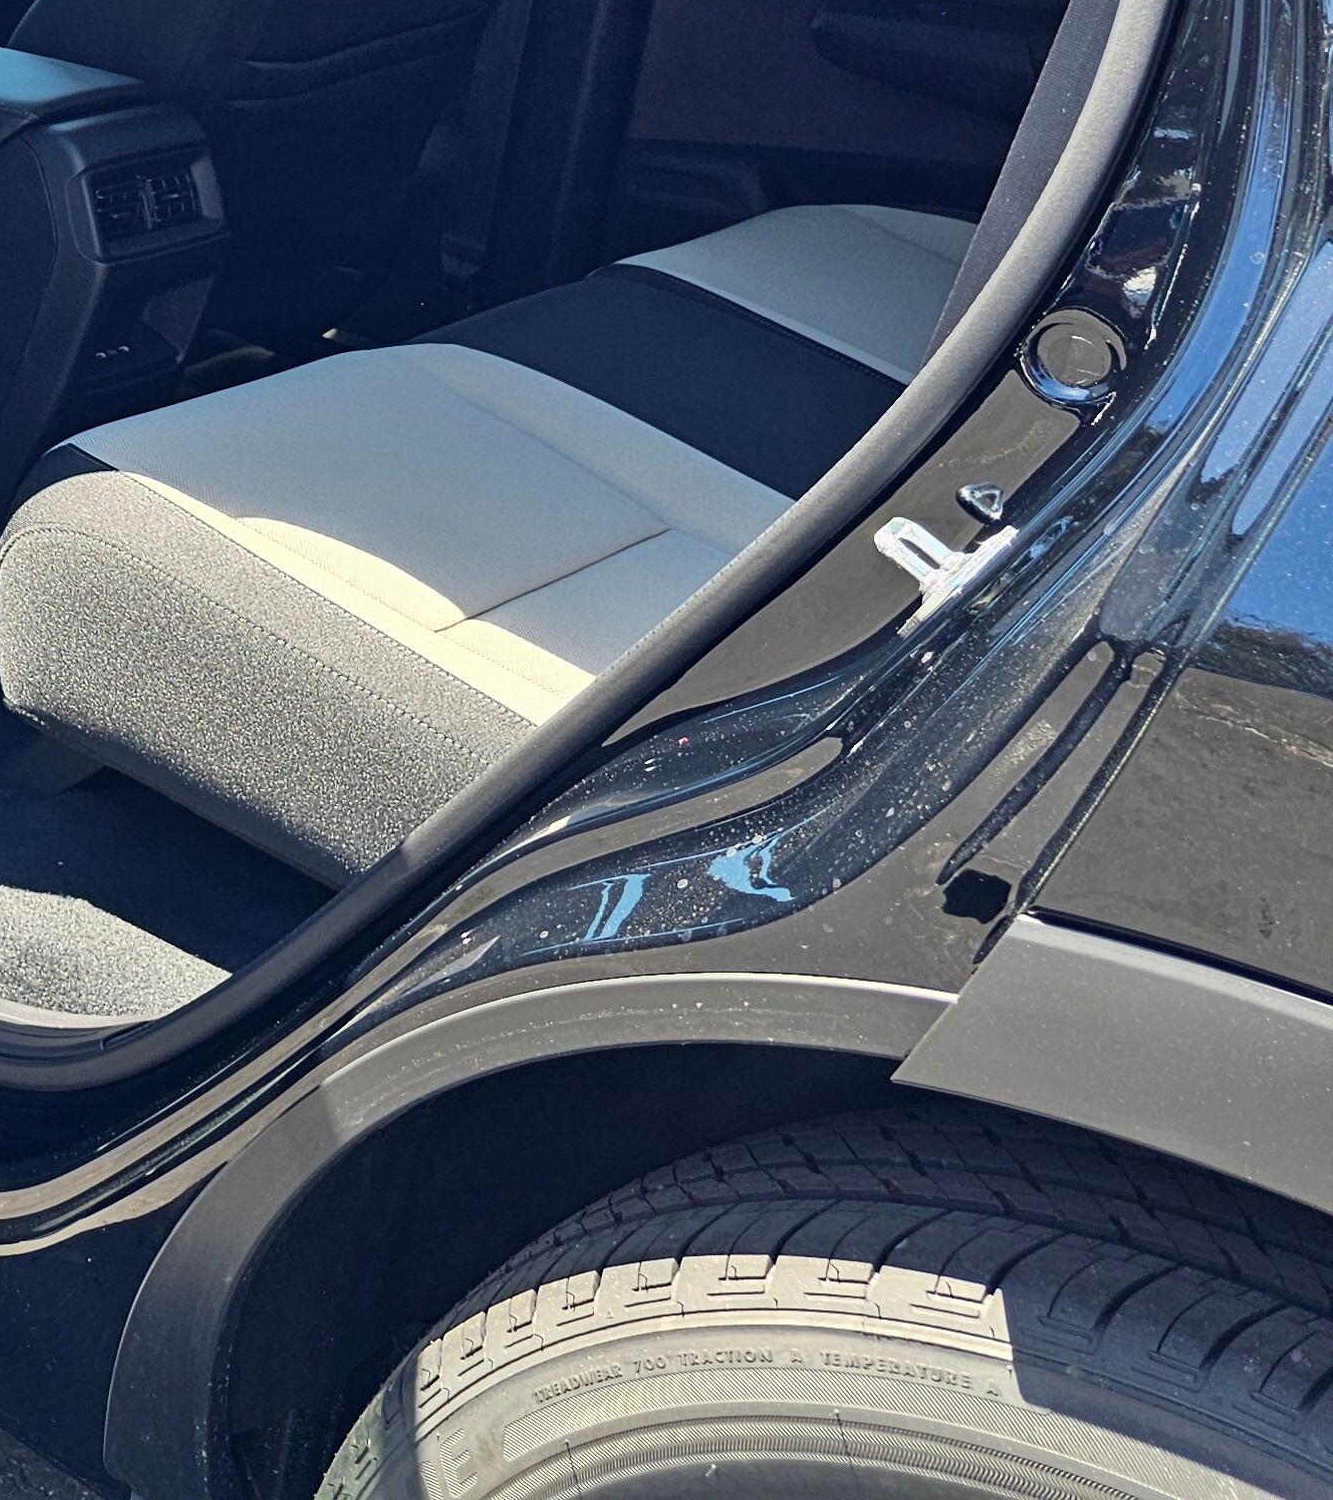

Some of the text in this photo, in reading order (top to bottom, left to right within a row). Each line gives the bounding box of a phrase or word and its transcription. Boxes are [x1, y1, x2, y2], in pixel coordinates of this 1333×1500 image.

[532, 1362, 623, 1404] TREADWEAR
[633, 1354, 668, 1375] 700
[678, 1348, 774, 1368] TRACTION
[790, 1347, 803, 1365] A
[818, 1349, 973, 1391] TEMPERATURE
